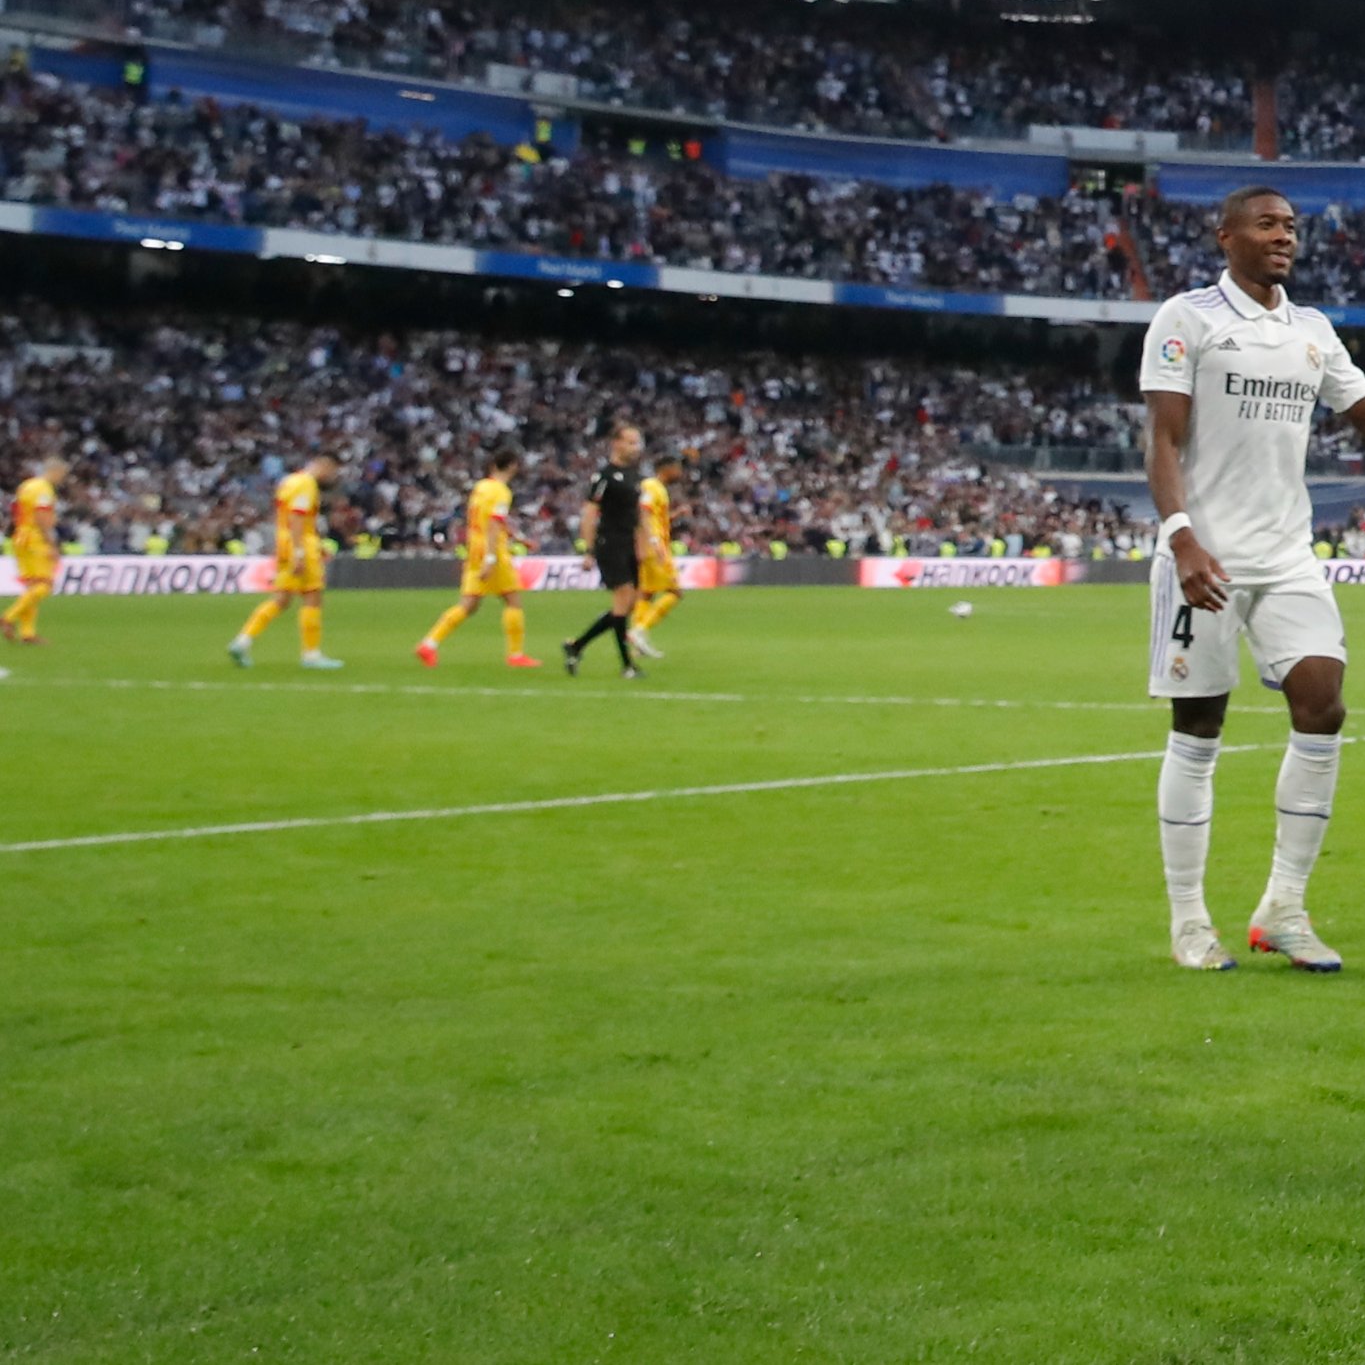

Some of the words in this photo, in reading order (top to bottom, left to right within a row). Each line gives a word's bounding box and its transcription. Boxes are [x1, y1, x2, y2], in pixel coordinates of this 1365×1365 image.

[1224, 372, 1318, 403] Emirates
[1238, 400, 1260, 420] FLY
[1264, 404, 1305, 424] BETTER
[1171, 604, 1195, 649] 4
